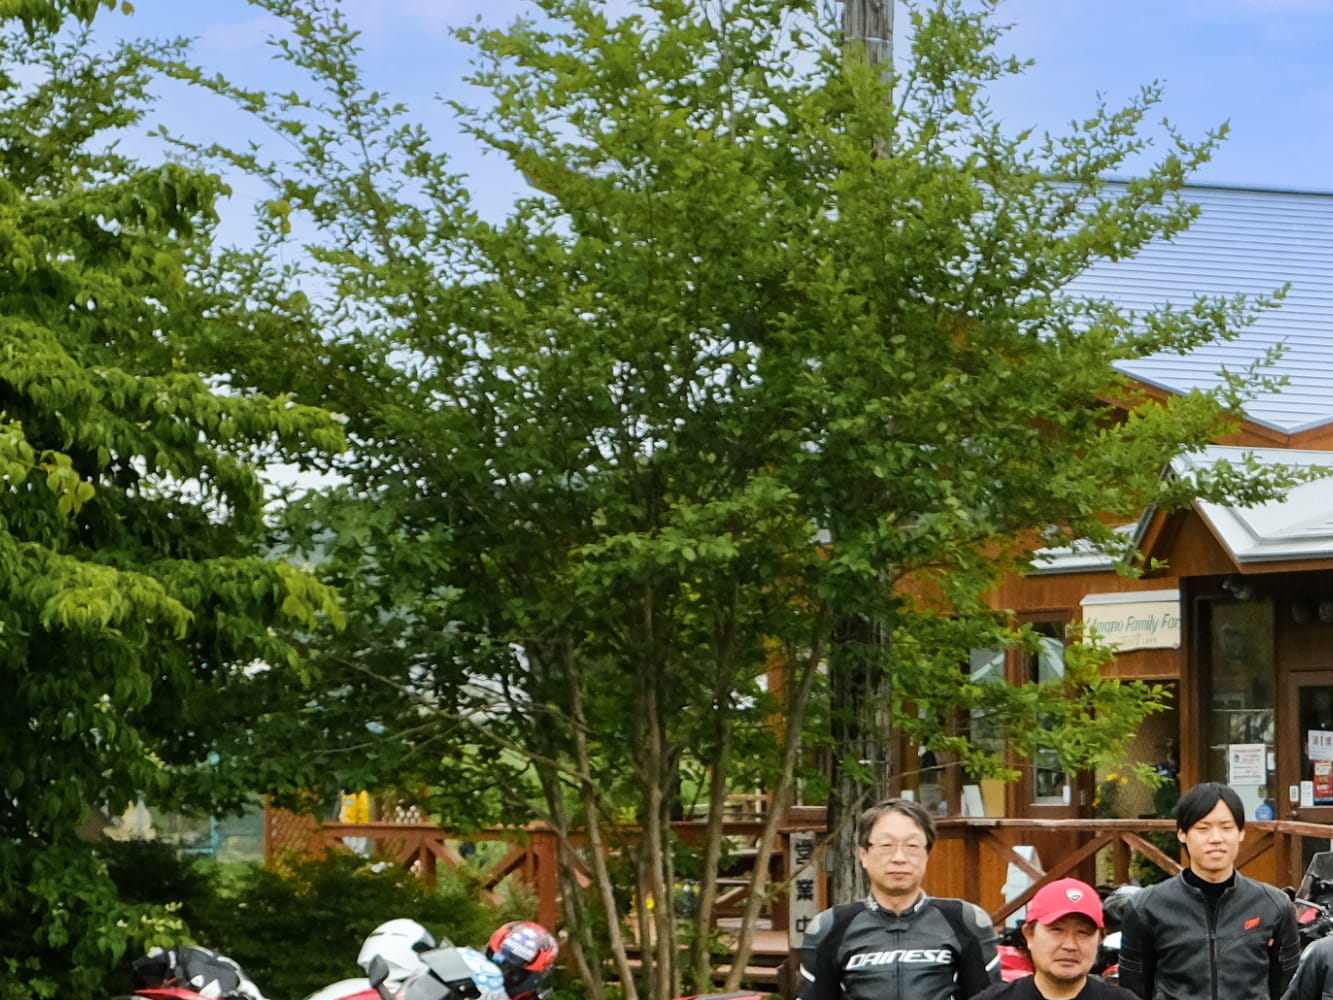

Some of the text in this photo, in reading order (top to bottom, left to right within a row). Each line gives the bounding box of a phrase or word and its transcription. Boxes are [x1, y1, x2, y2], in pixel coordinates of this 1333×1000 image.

[1125, 615, 1158, 633] Family
[1161, 612, 1180, 630] Far
[846, 949, 952, 970] DAINESE
